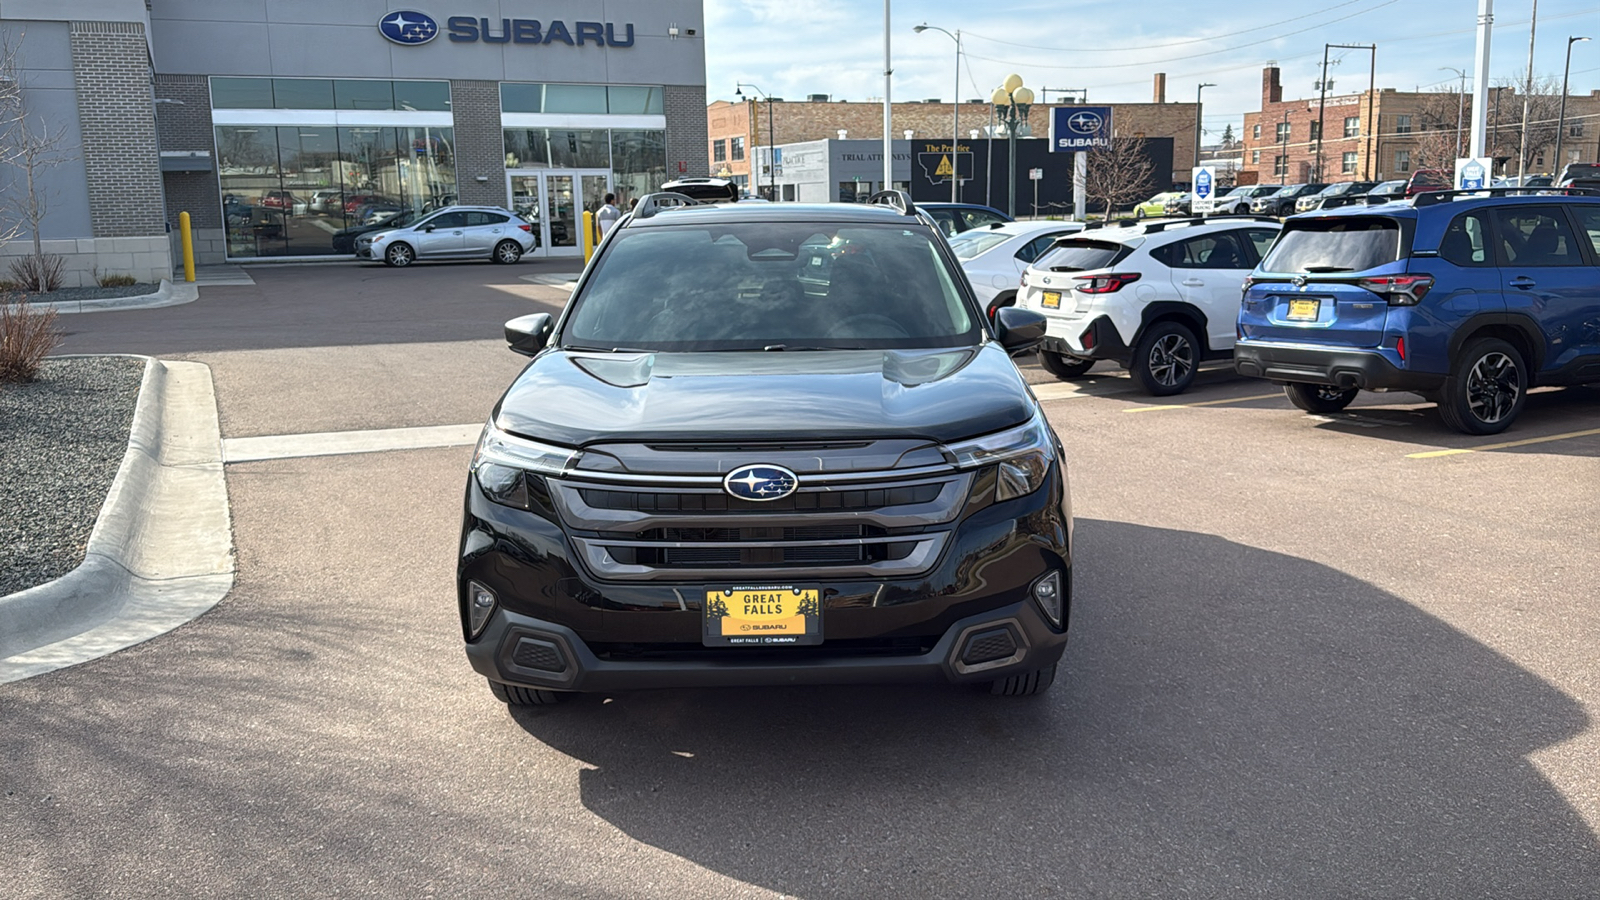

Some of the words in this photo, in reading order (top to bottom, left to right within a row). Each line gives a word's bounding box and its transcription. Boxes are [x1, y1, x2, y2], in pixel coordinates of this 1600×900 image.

[447, 16, 635, 48] SUBARU
[1058, 138, 1108, 148] SUBARU
[925, 144, 940, 152] The
[941, 144, 970, 152] Pratice
[842, 153, 865, 161] TRIAL
[743, 594, 782, 603] GREAT
[744, 604, 782, 614] FALLS
